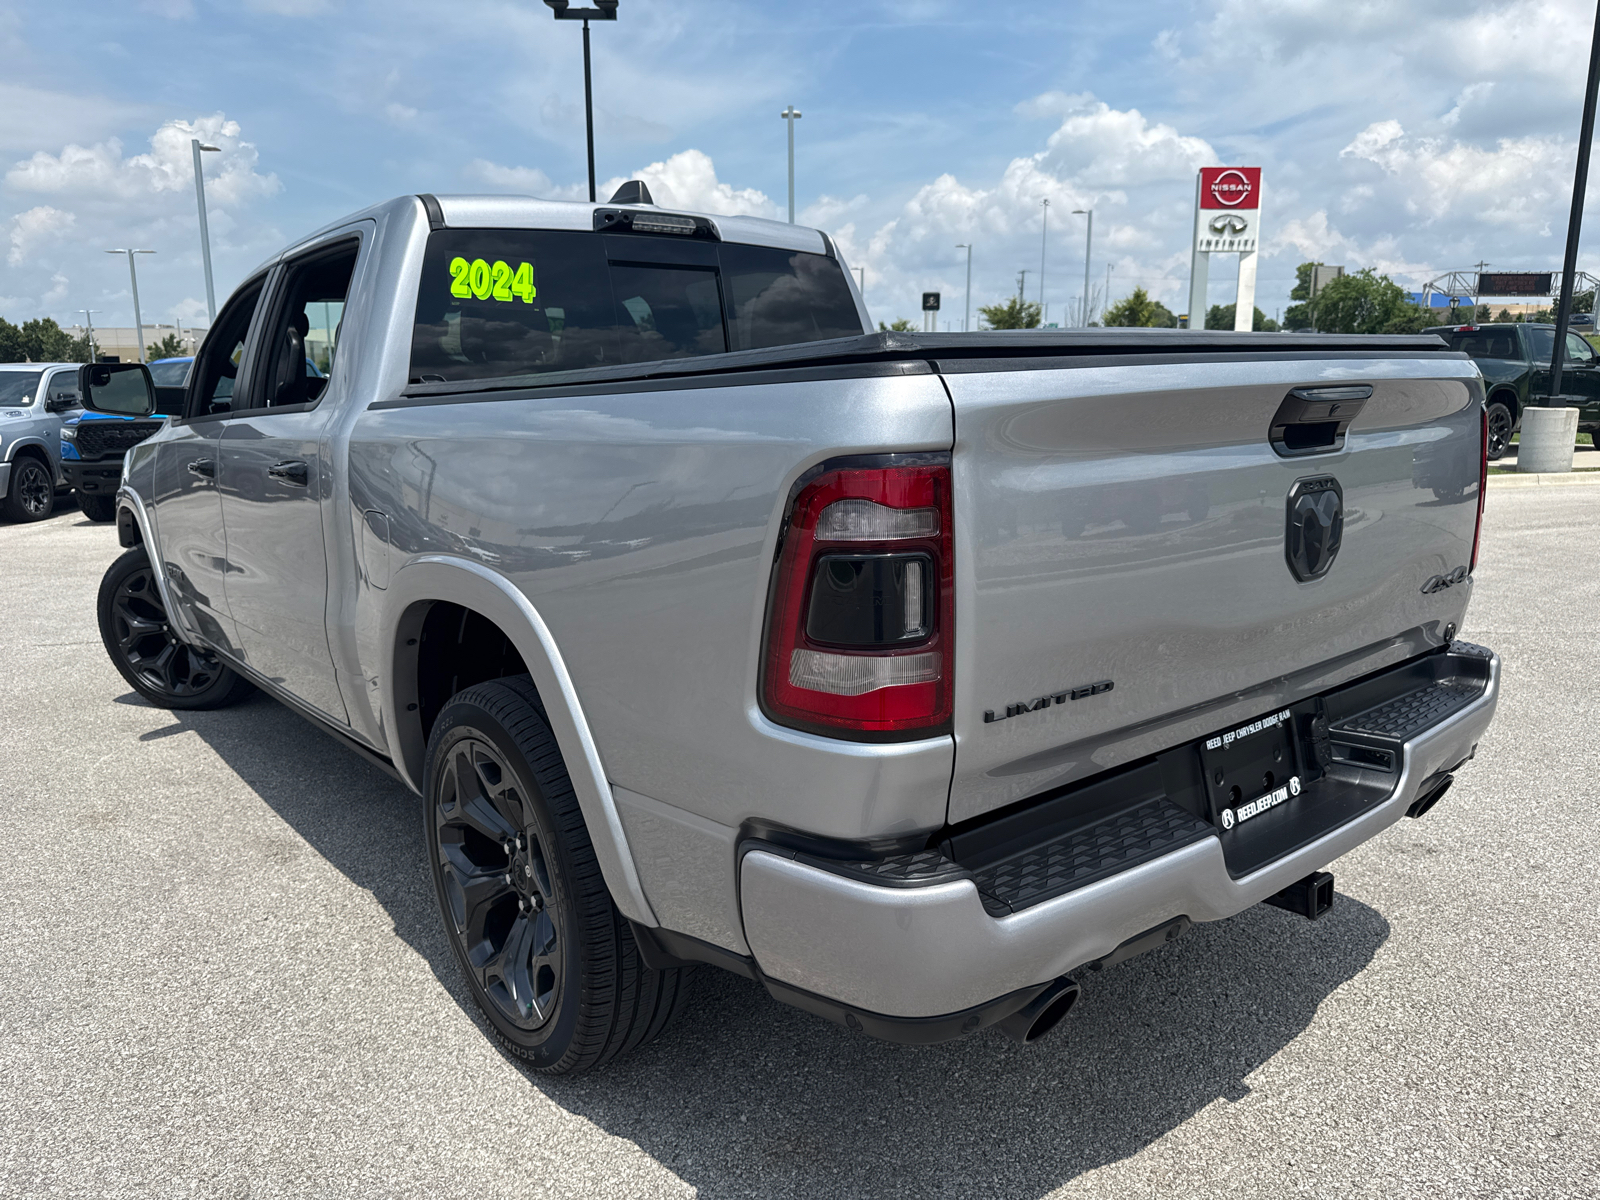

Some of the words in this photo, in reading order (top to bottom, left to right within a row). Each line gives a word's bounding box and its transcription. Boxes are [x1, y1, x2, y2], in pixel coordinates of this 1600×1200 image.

[1200, 239, 1255, 248] INFINITI
[449, 256, 536, 304] 2024
[1303, 480, 1334, 491] RAM
[984, 680, 1115, 723] LIMITED
[1206, 736, 1221, 750] REED
[1223, 731, 1235, 745] JEEP
[1236, 721, 1262, 739] CHRYSLER
[1263, 714, 1279, 729] DODGE
[1279, 709, 1291, 721] RAM
[1237, 787, 1289, 822] REEDJEEP.COM
